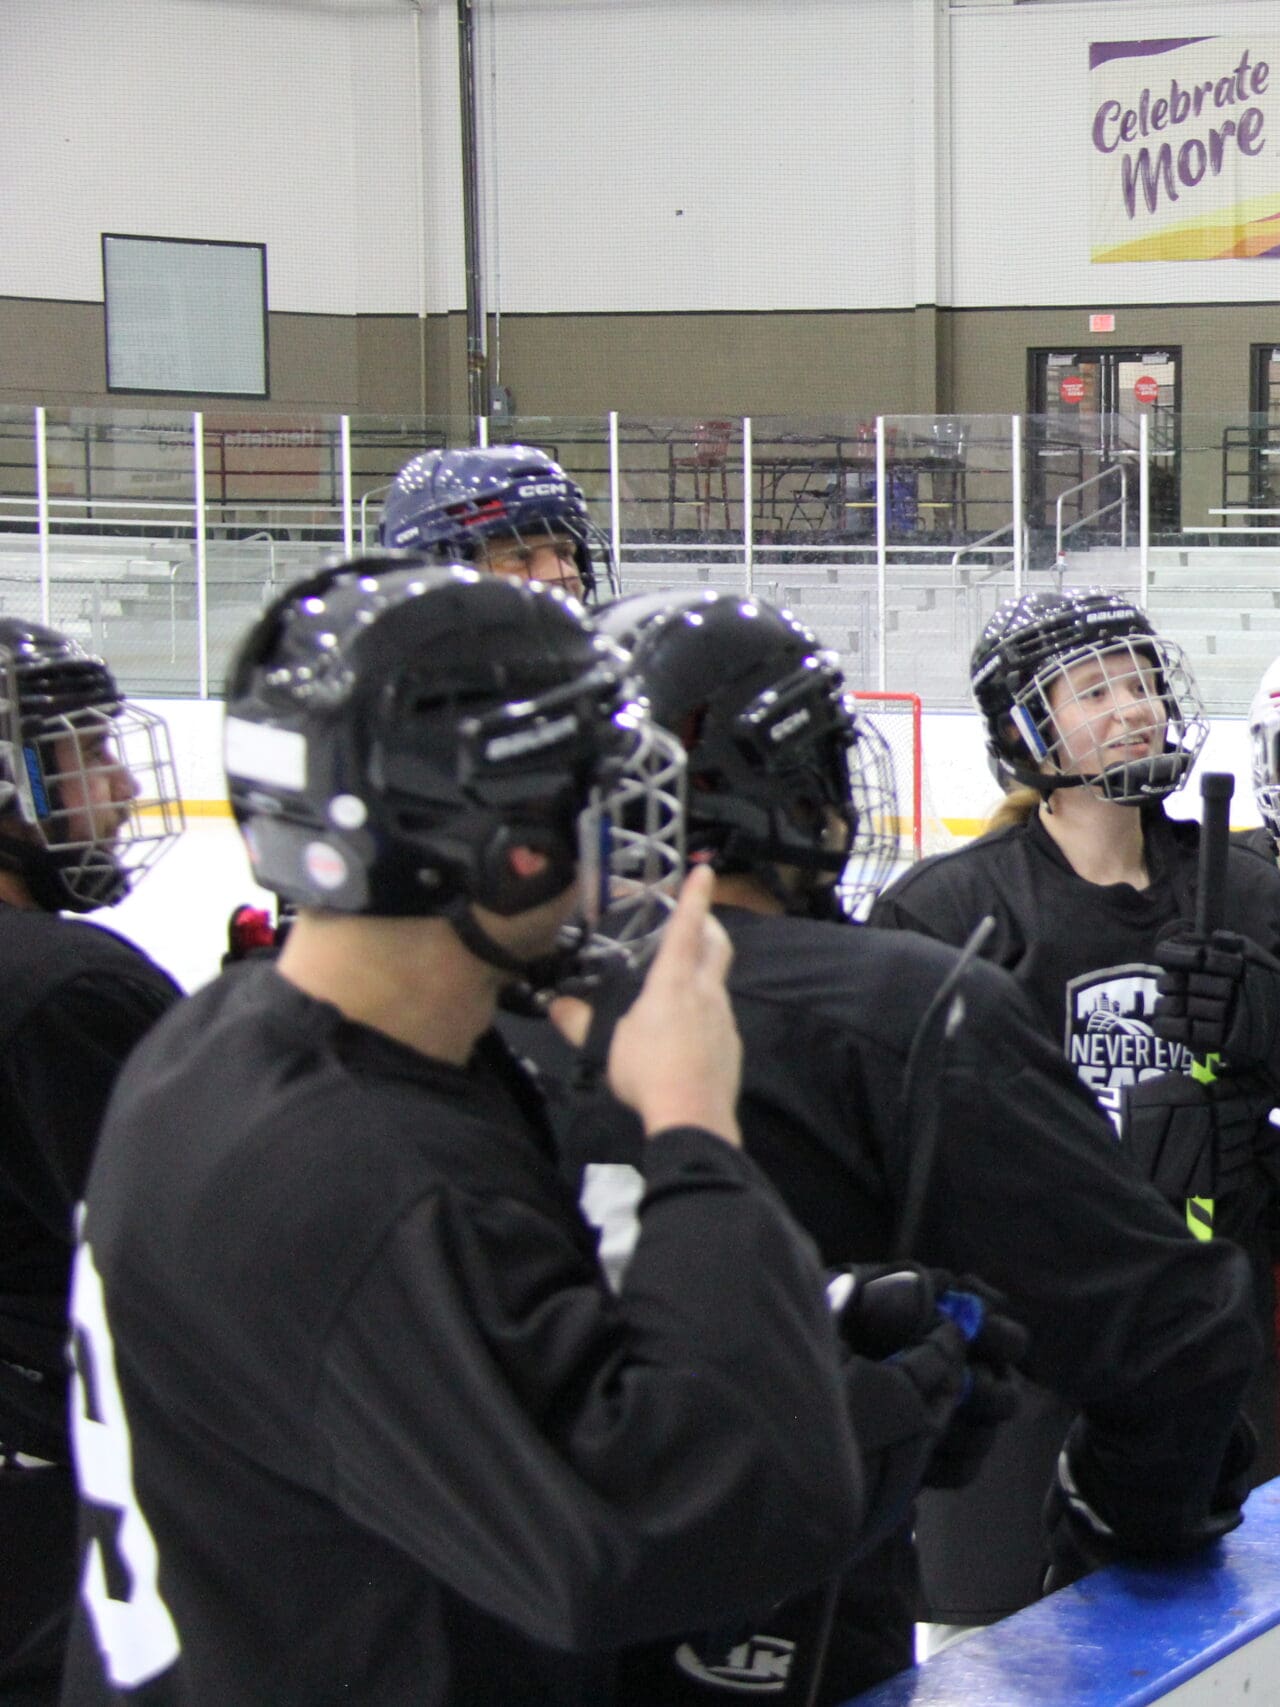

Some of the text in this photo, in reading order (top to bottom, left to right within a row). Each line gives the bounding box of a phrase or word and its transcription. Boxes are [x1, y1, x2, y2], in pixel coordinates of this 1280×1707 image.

[1092, 49, 1269, 153] Celebrate
[1121, 107, 1265, 220] More
[519, 483, 567, 497] CCM
[1087, 609, 1135, 623] BAUER
[1071, 1033, 1150, 1067] NEVER
